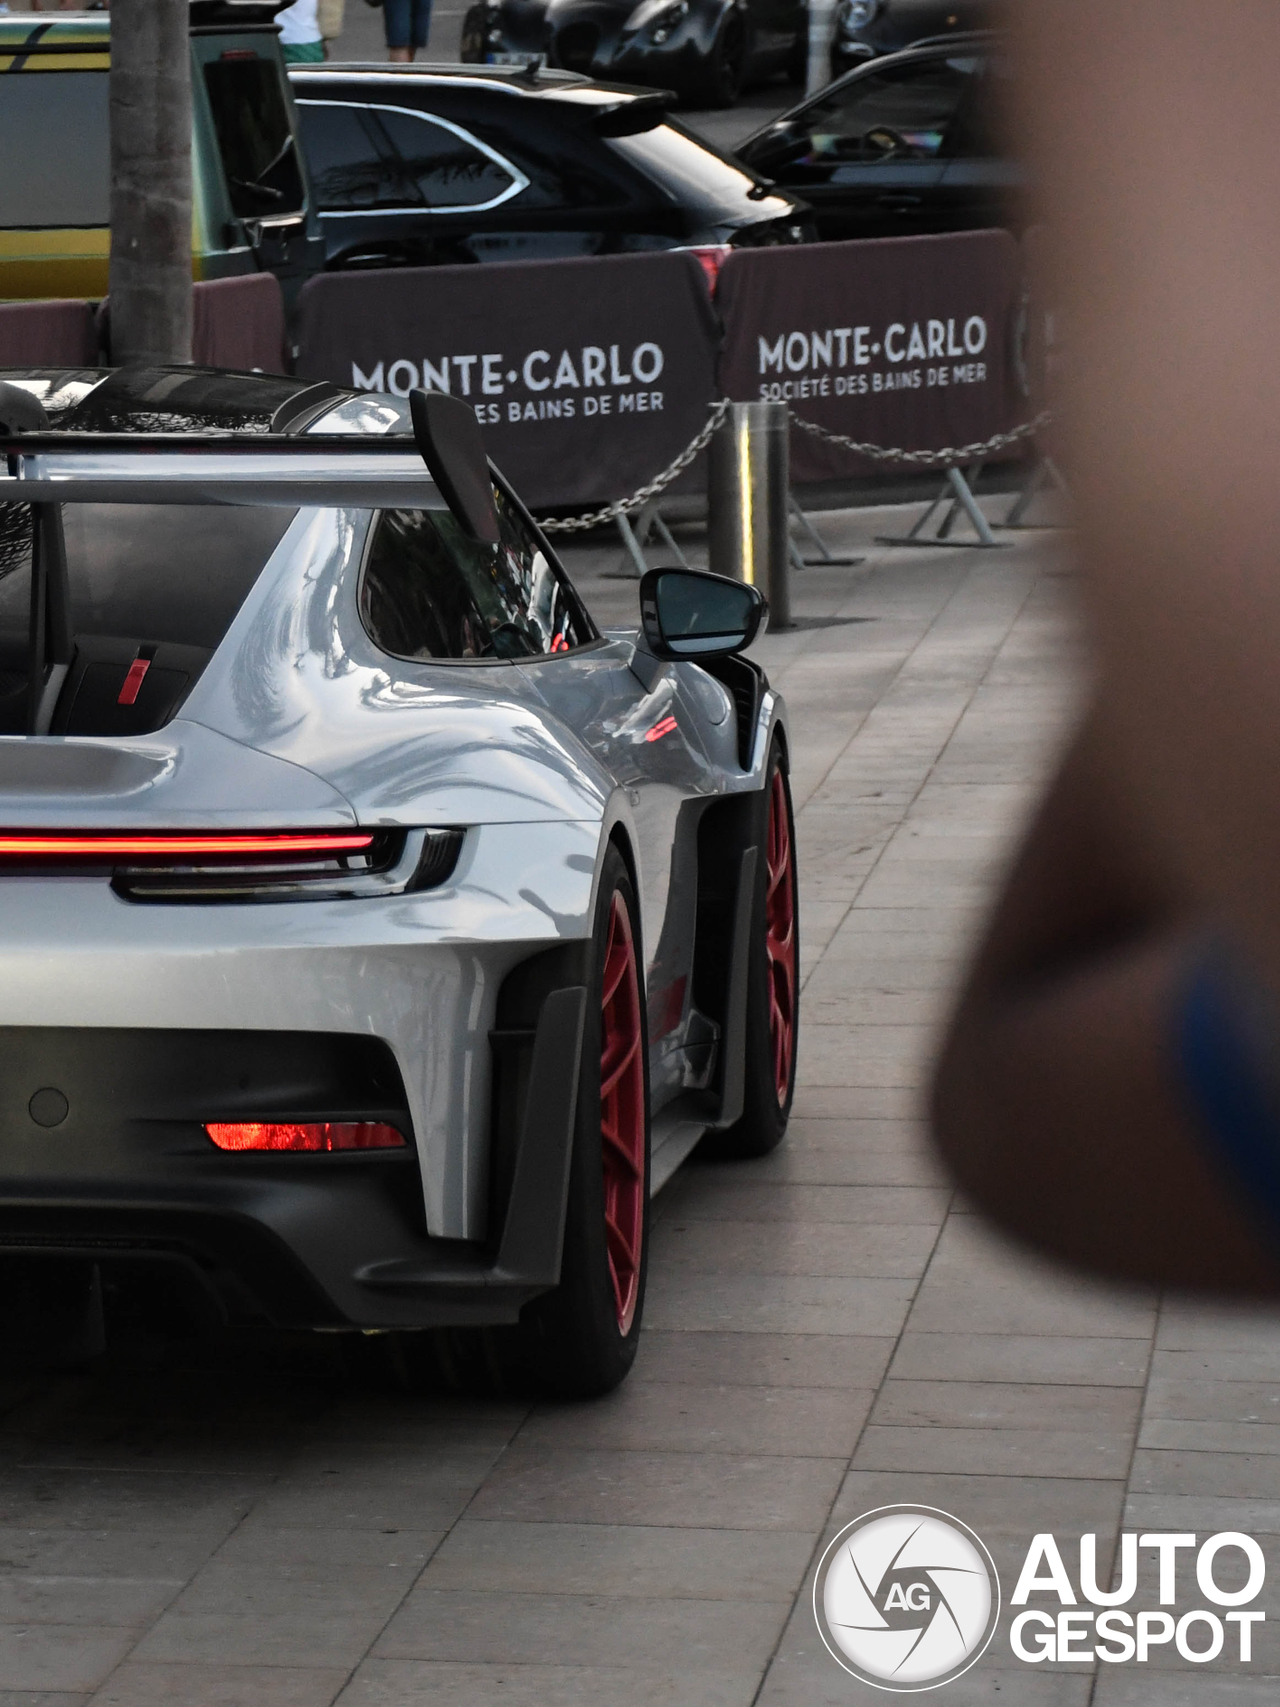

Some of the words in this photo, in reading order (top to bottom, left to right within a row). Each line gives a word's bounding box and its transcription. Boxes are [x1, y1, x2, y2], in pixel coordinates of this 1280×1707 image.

[759, 374, 830, 401] SOCIÉTÉ
[835, 374, 868, 395] DES
[872, 369, 922, 392] BAINS
[927, 366, 949, 387] DE
[953, 362, 986, 384] MER
[474, 403, 501, 424] ES
[508, 398, 575, 422] BAINS
[584, 395, 613, 416] DE
[619, 391, 664, 413] MER
